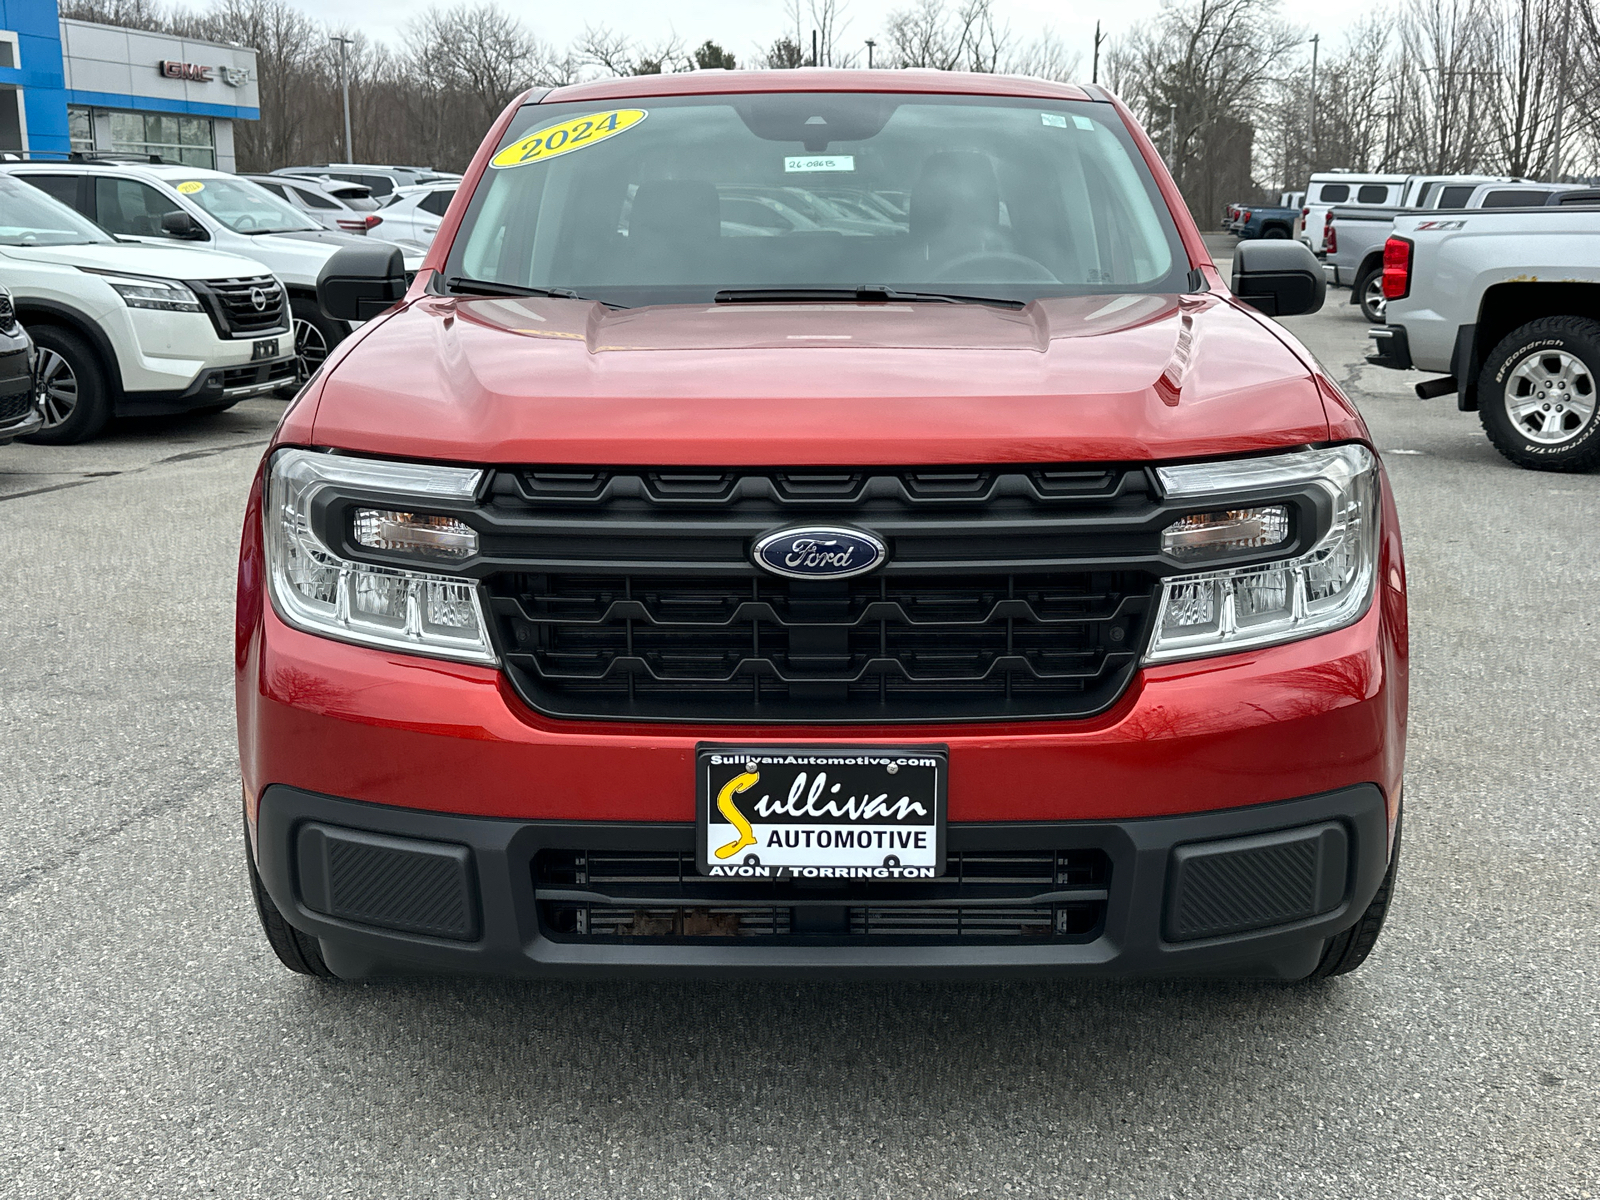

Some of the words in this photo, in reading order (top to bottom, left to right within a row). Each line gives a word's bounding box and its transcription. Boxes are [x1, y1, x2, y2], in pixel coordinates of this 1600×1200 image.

[161, 60, 214, 82] GMC
[519, 113, 622, 162] 2024
[1413, 219, 1468, 232] Z71
[1495, 338, 1565, 383] BFGoodrich
[1547, 406, 1600, 455] ll-Terrain
[785, 539, 855, 567] Ford
[710, 755, 937, 767] SullivanAutomotive.com
[714, 771, 927, 860] Sullivan
[767, 830, 927, 849] AUTOMOTIVE
[709, 867, 770, 877] AVON
[789, 867, 935, 878] TORRINGTON
